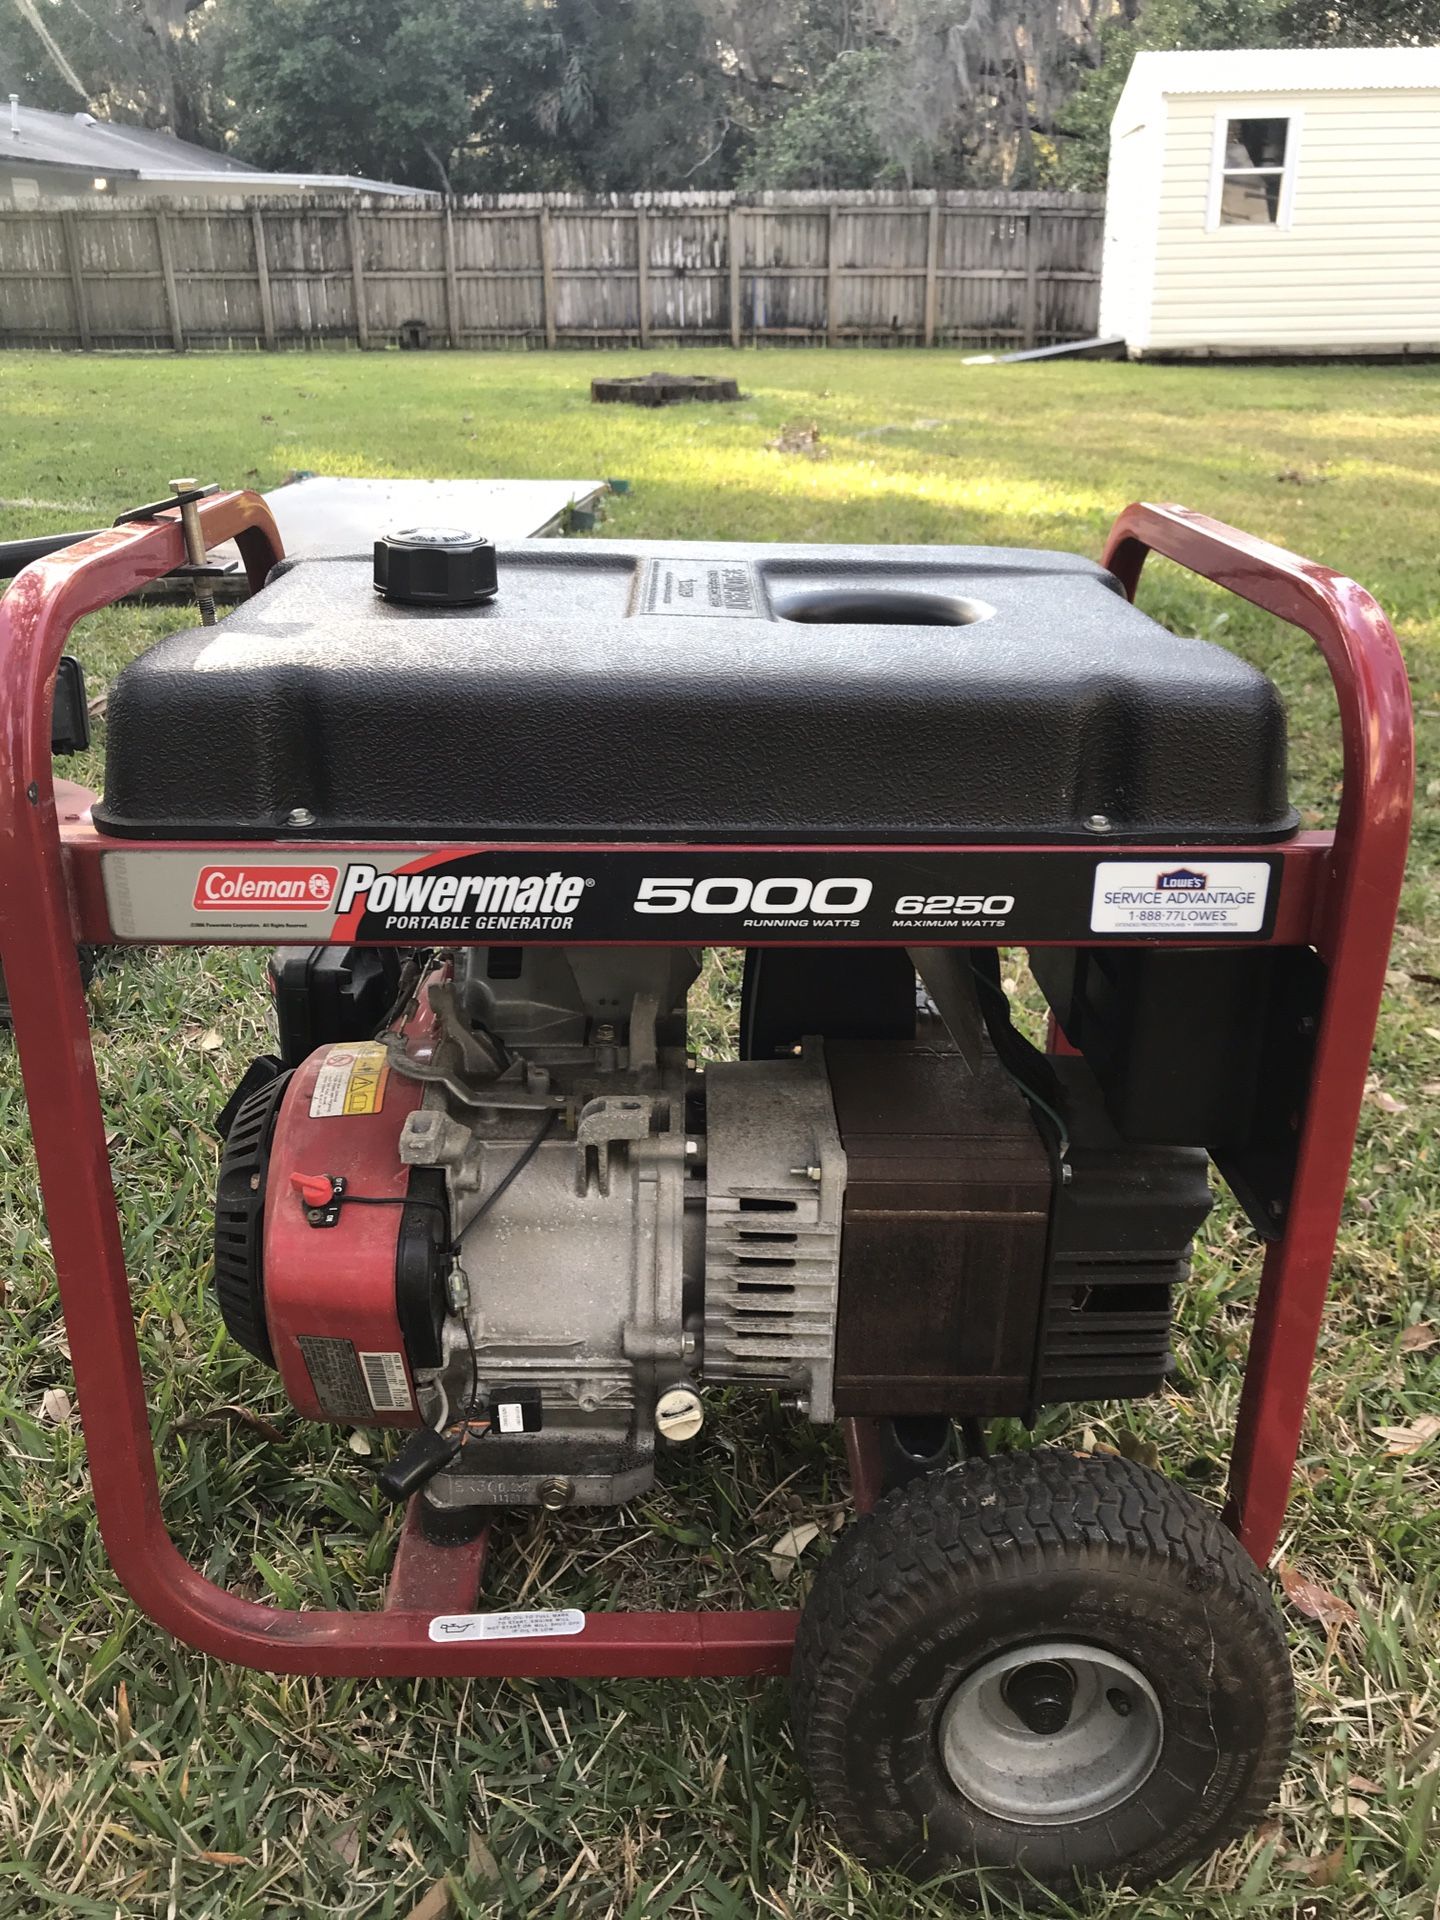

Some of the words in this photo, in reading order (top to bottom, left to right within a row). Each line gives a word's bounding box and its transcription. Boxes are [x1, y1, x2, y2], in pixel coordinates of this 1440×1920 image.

[205, 872, 306, 899] Coleman
[1162, 877, 1202, 888] LOWE'S
[633, 877, 873, 914] 5000
[1104, 892, 1162, 904] SERVICE
[1166, 892, 1256, 904] ADVANTAGE
[894, 895, 1015, 915] 6250
[385, 916, 471, 930] PORTABLE
[475, 916, 574, 930] GENERATOR
[743, 919, 808, 927] RUNNING
[812, 919, 860, 927] WATTS
[892, 919, 958, 927] MAXIMUM
[960, 919, 1006, 927] WATTS
